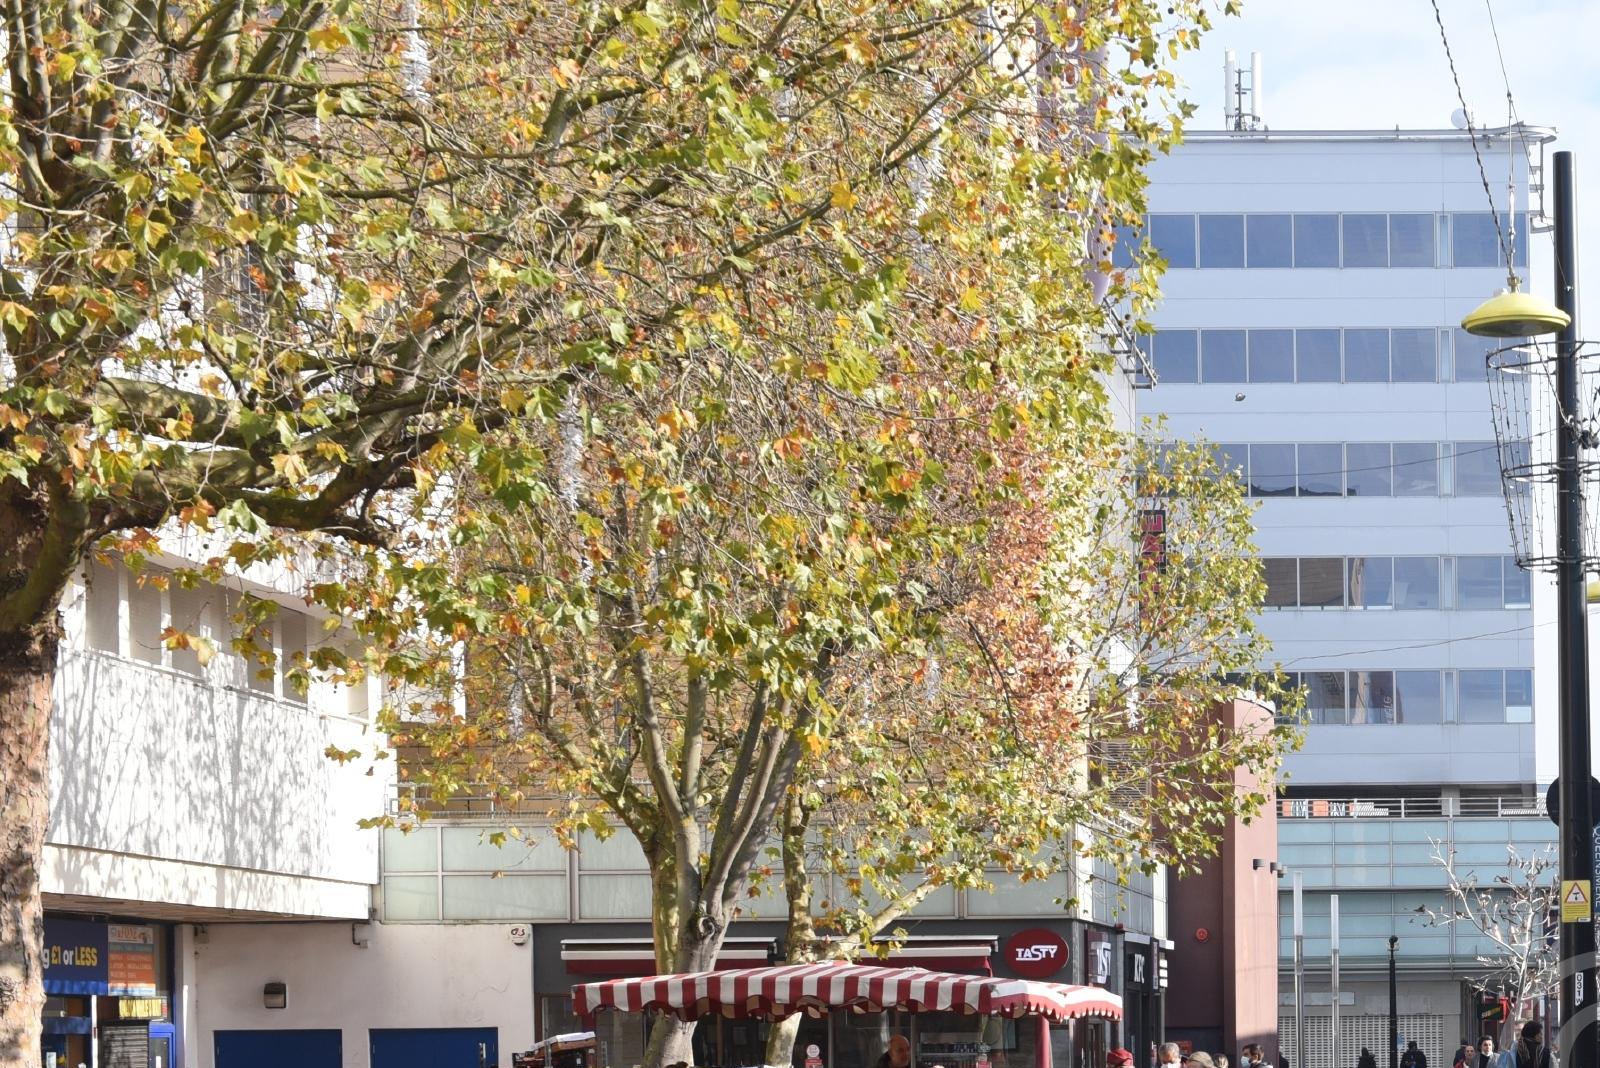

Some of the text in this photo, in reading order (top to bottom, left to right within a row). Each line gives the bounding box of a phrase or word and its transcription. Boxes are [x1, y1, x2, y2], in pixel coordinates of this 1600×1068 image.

[51, 945, 61, 965] £1
[63, 950, 74, 966] or
[75, 946, 98, 967] LESS
[1015, 945, 1058, 962] TASTY
